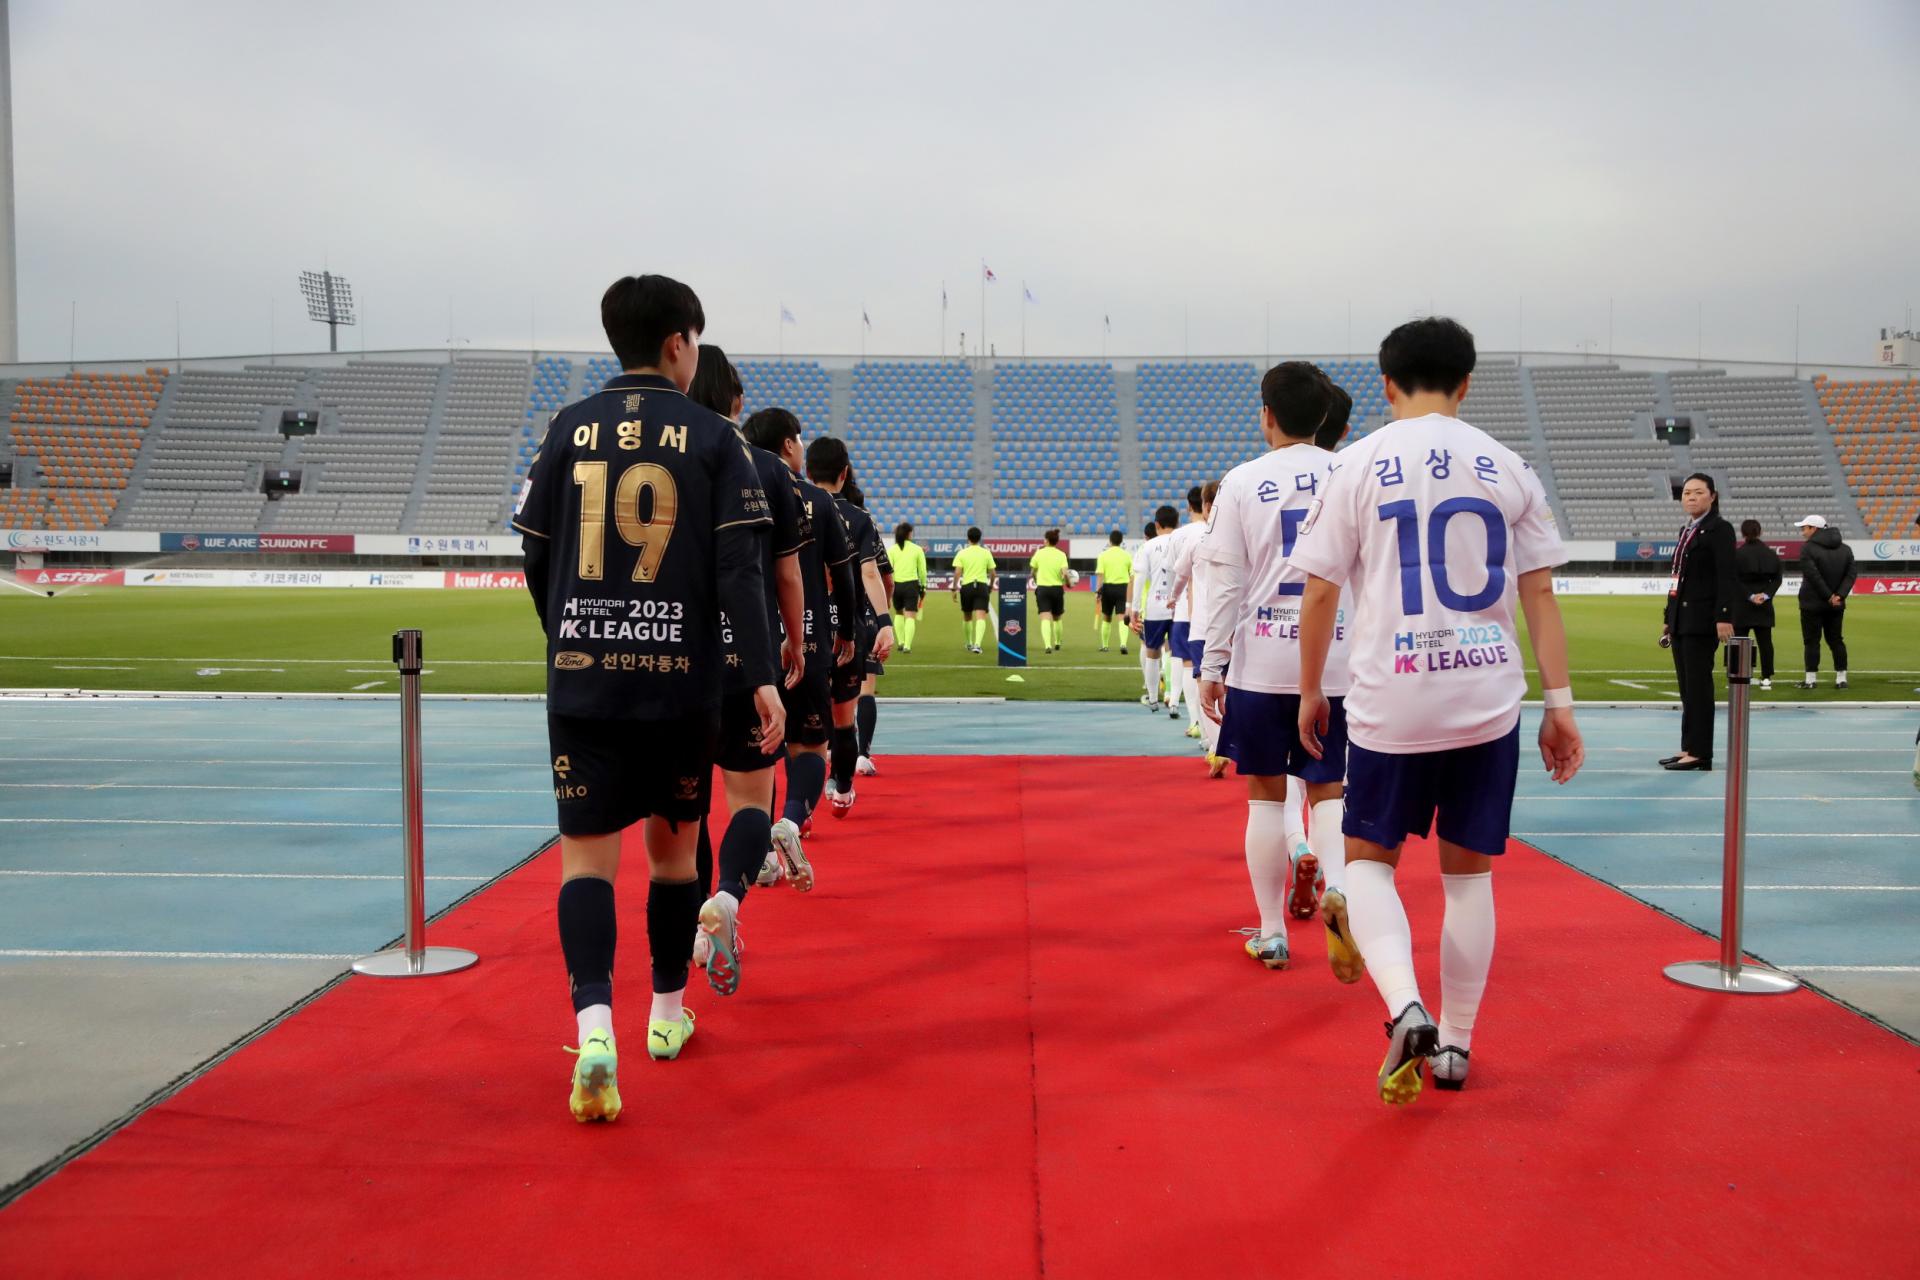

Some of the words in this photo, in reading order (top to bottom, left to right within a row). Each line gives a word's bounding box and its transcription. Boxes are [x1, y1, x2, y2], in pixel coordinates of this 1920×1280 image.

[573, 420, 687, 453] 이영서
[1375, 449, 1498, 487] 김상은
[1258, 473, 1317, 503] 손다
[574, 461, 678, 583] 19
[204, 538, 225, 548] WE
[227, 538, 257, 549] ARE
[259, 538, 308, 549] SUWON
[310, 539, 328, 549] FC
[424, 537, 488, 551] 수원특례시
[934, 543, 952, 553] WE
[1378, 497, 1507, 616] 10
[263, 573, 322, 585] 키코캐리어
[580, 599, 625, 608] HYUNDAI
[628, 600, 684, 620] 2023
[580, 608, 612, 616] STEEL
[589, 620, 683, 642] LEAGUE
[1415, 629, 1455, 640] HYUNDAI
[1457, 624, 1503, 646] 2023
[1416, 640, 1444, 649] STEEL
[601, 653, 690, 674] 선인자동차
[1428, 645, 1508, 671] LEAGUE
